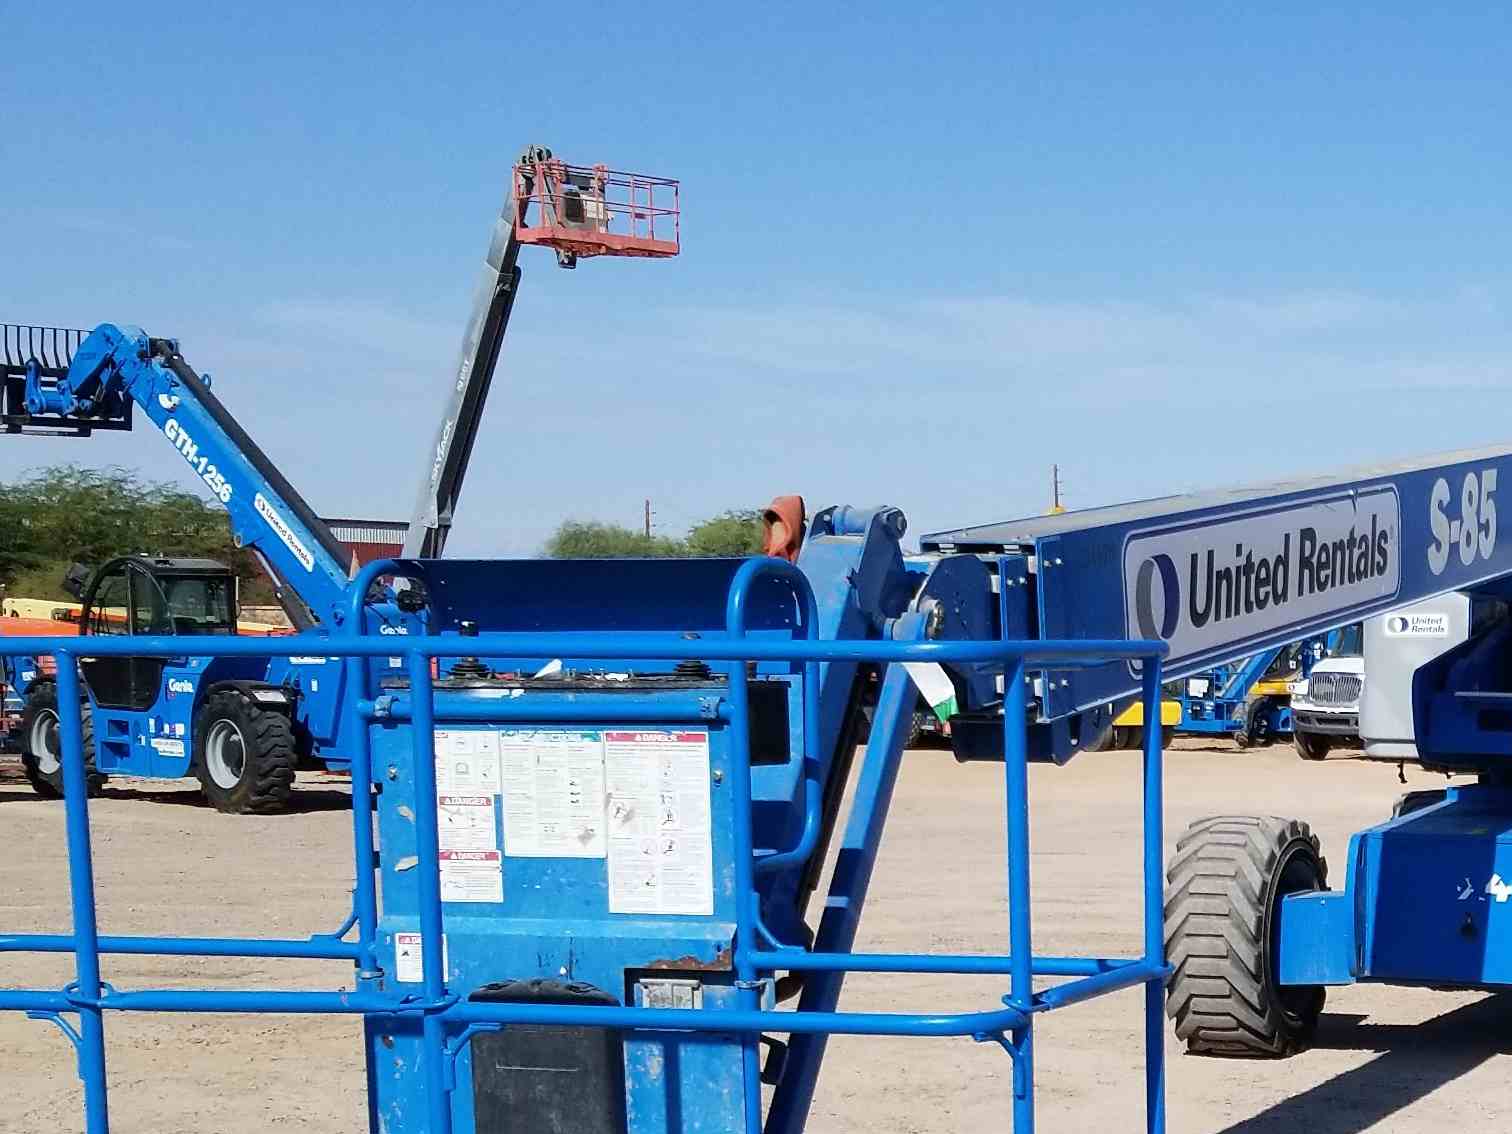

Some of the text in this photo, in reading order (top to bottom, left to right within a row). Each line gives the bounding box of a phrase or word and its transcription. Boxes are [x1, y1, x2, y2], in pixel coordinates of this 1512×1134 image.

[164, 418, 233, 502] GTH-1256
[264, 505, 288, 539] United
[1427, 468, 1498, 576] S-85
[1188, 513, 1389, 629] United Rentals
[1411, 616, 1443, 625] United
[1411, 625, 1445, 633] Rentals
